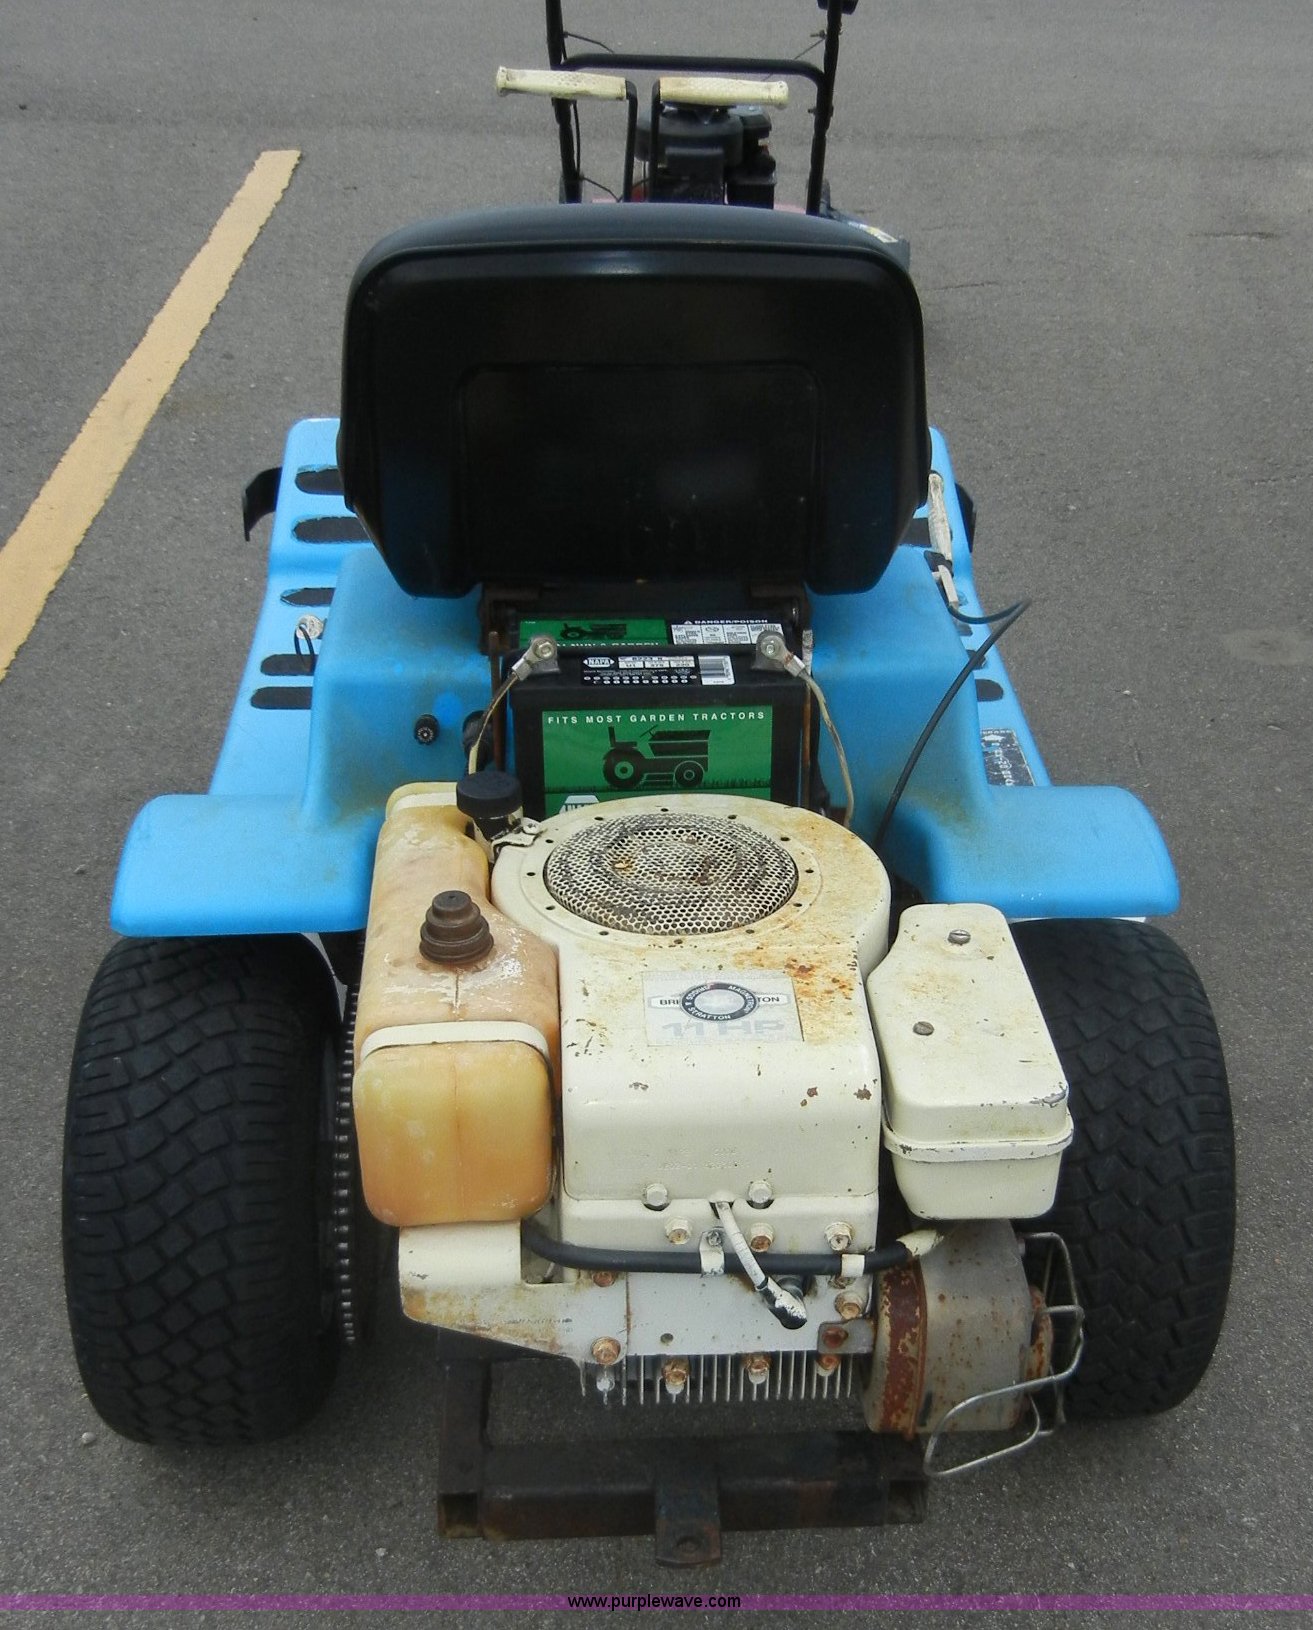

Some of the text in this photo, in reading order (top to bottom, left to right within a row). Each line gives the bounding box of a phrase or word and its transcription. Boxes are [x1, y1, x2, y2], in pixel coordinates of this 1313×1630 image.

[588, 658, 611, 666] NAPA
[548, 711, 765, 724] FITS MOST GARDEN TRACTORS
[688, 1007, 731, 1020] STRATTON
[718, 1020, 786, 1036] HP
